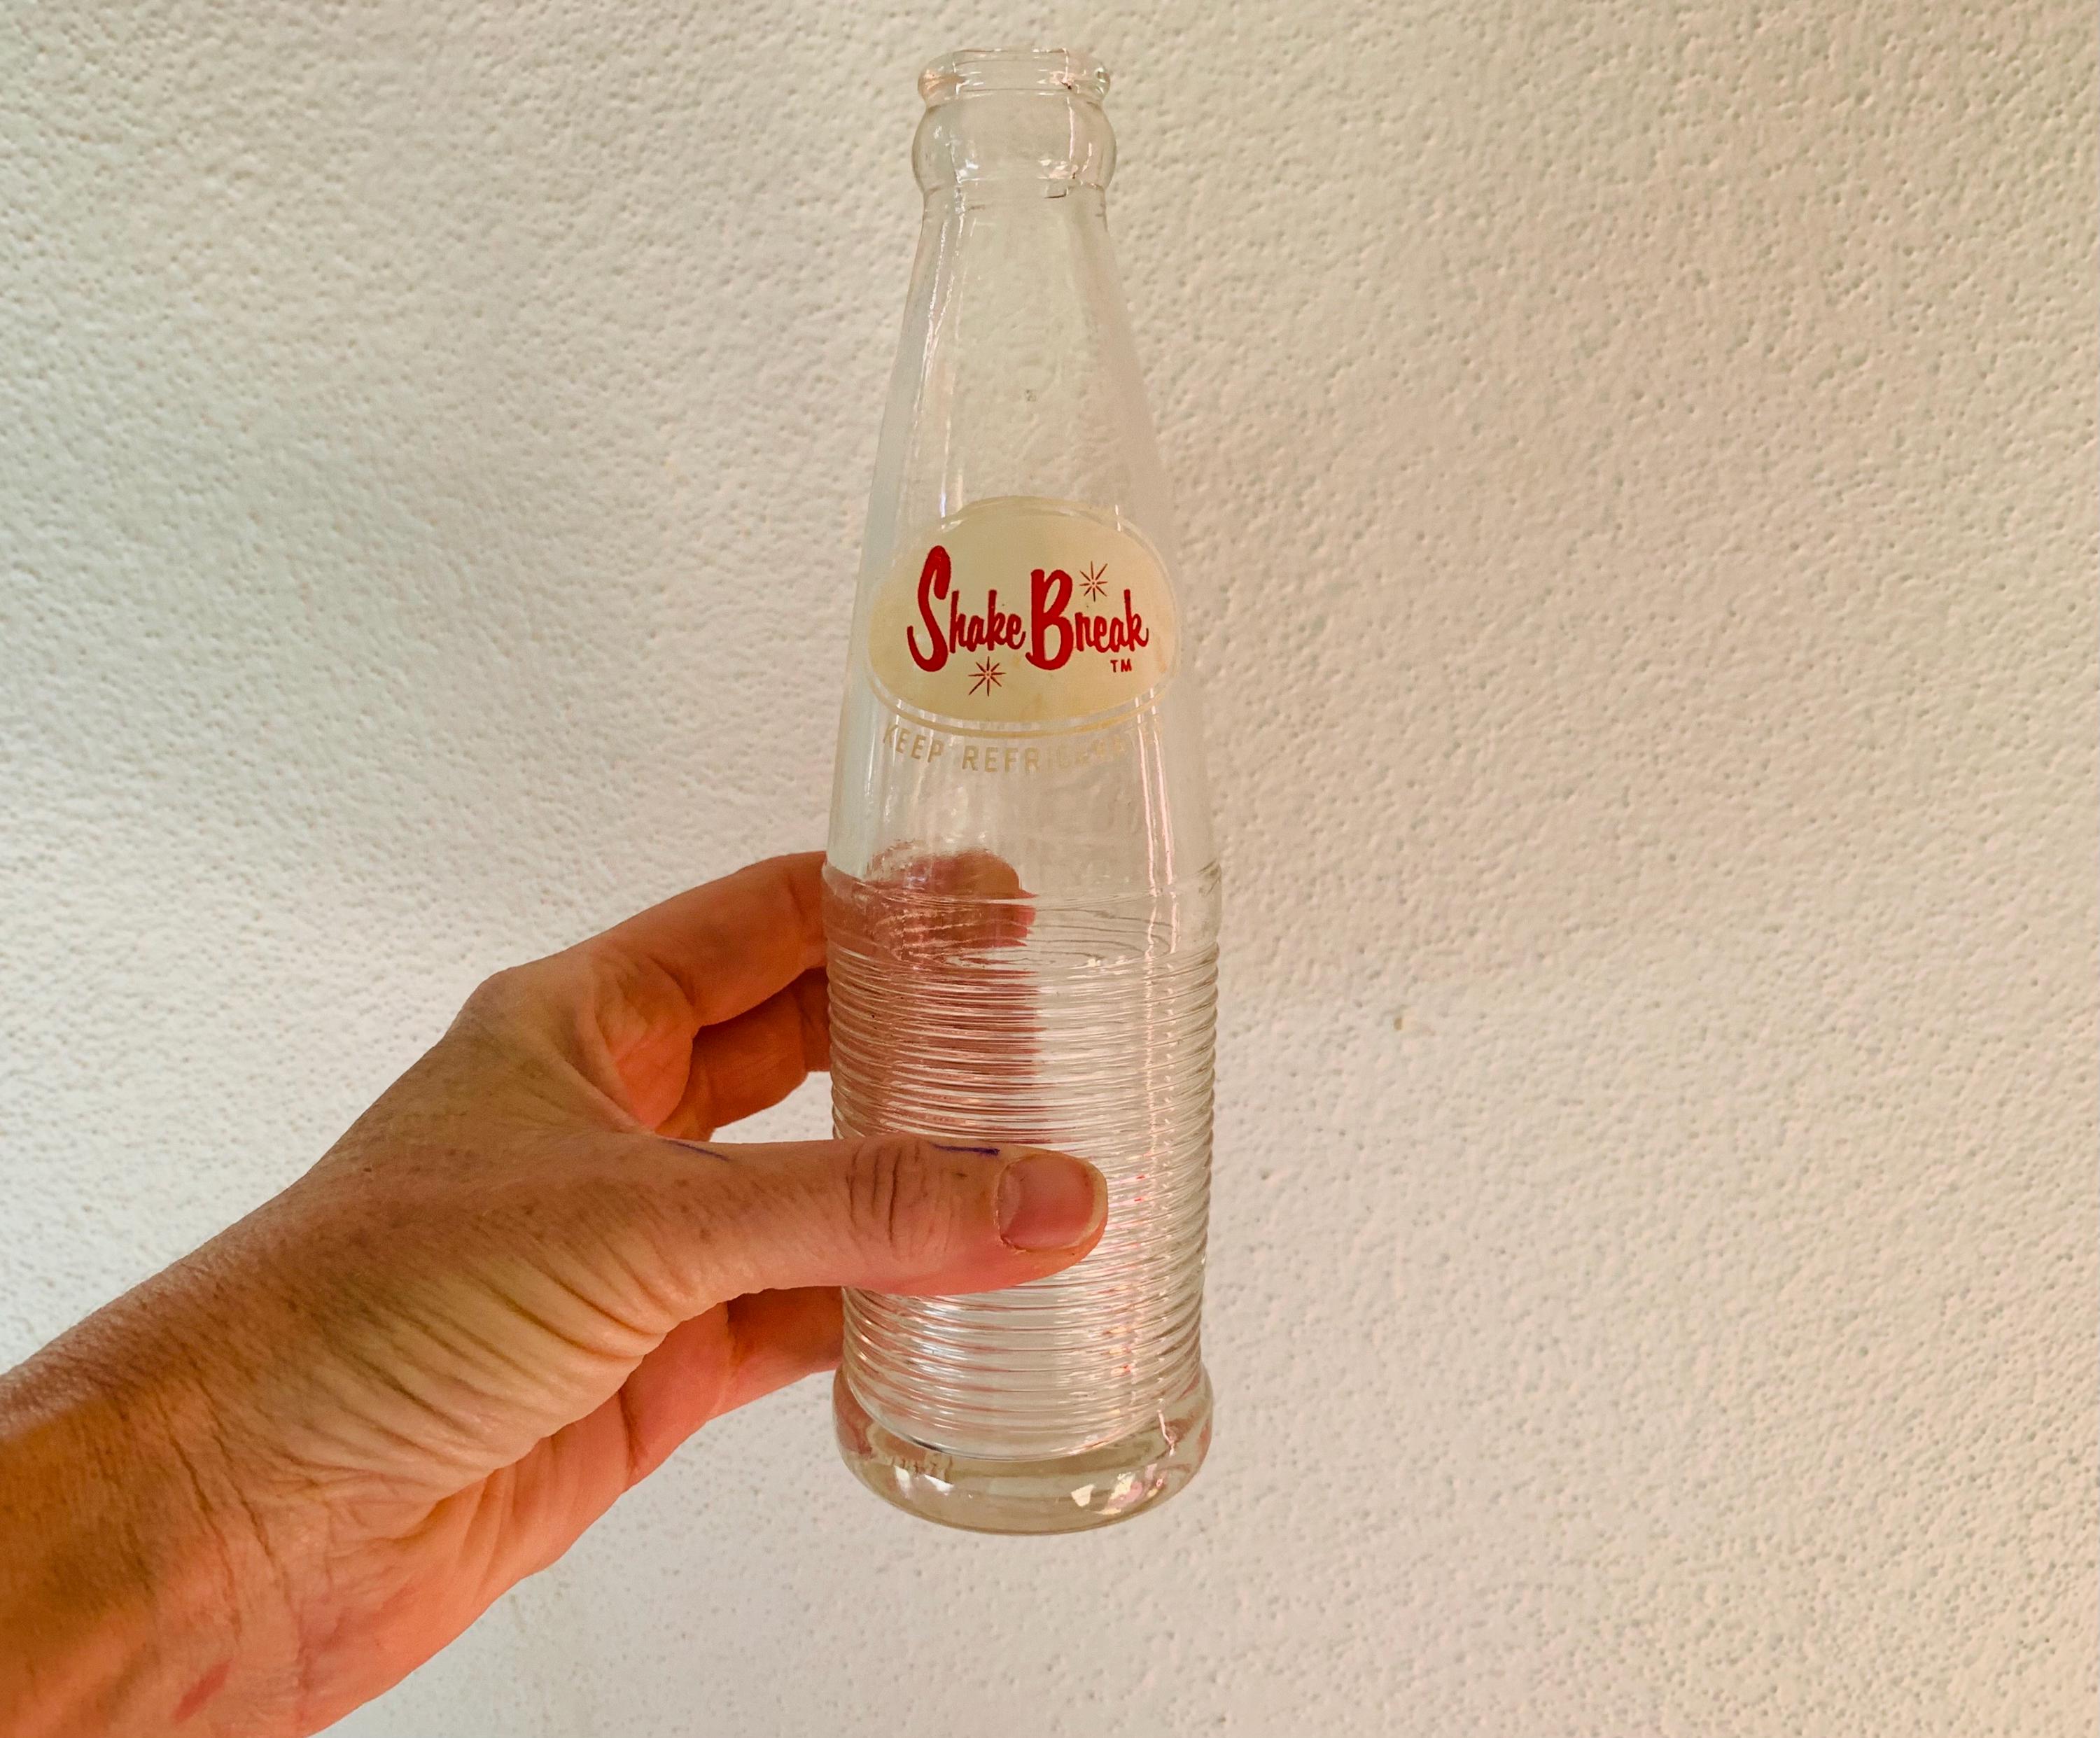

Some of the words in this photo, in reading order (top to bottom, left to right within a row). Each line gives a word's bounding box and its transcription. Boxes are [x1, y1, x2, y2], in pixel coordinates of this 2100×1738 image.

[907, 545, 1026, 672] Shake
[1026, 569, 1149, 670] Break
[1111, 659, 1133, 673] TM
[883, 722, 944, 763] KEEP
